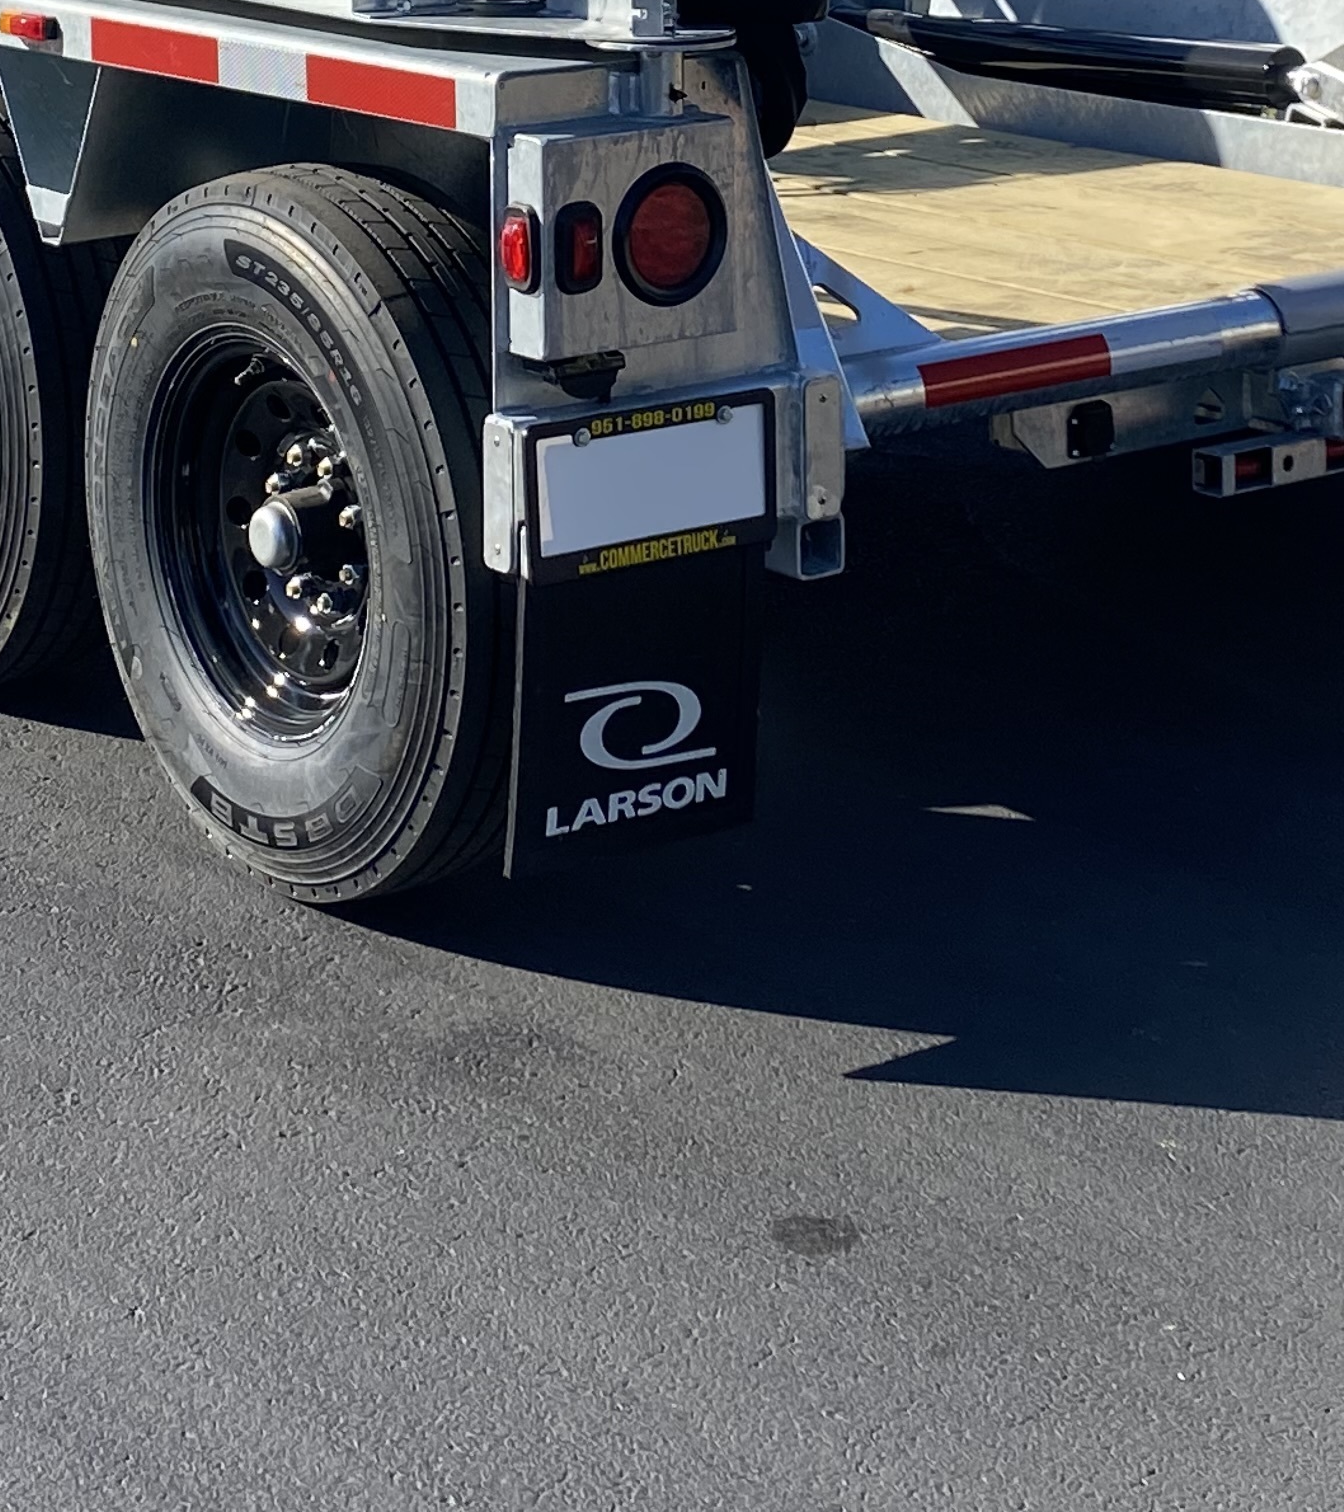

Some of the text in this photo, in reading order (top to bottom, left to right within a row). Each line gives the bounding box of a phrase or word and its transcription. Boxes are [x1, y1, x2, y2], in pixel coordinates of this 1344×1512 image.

[235, 254, 362, 406] ST235/85R16
[591, 402, 715, 435] 951-898-0199
[546, 768, 727, 837] LARSON
